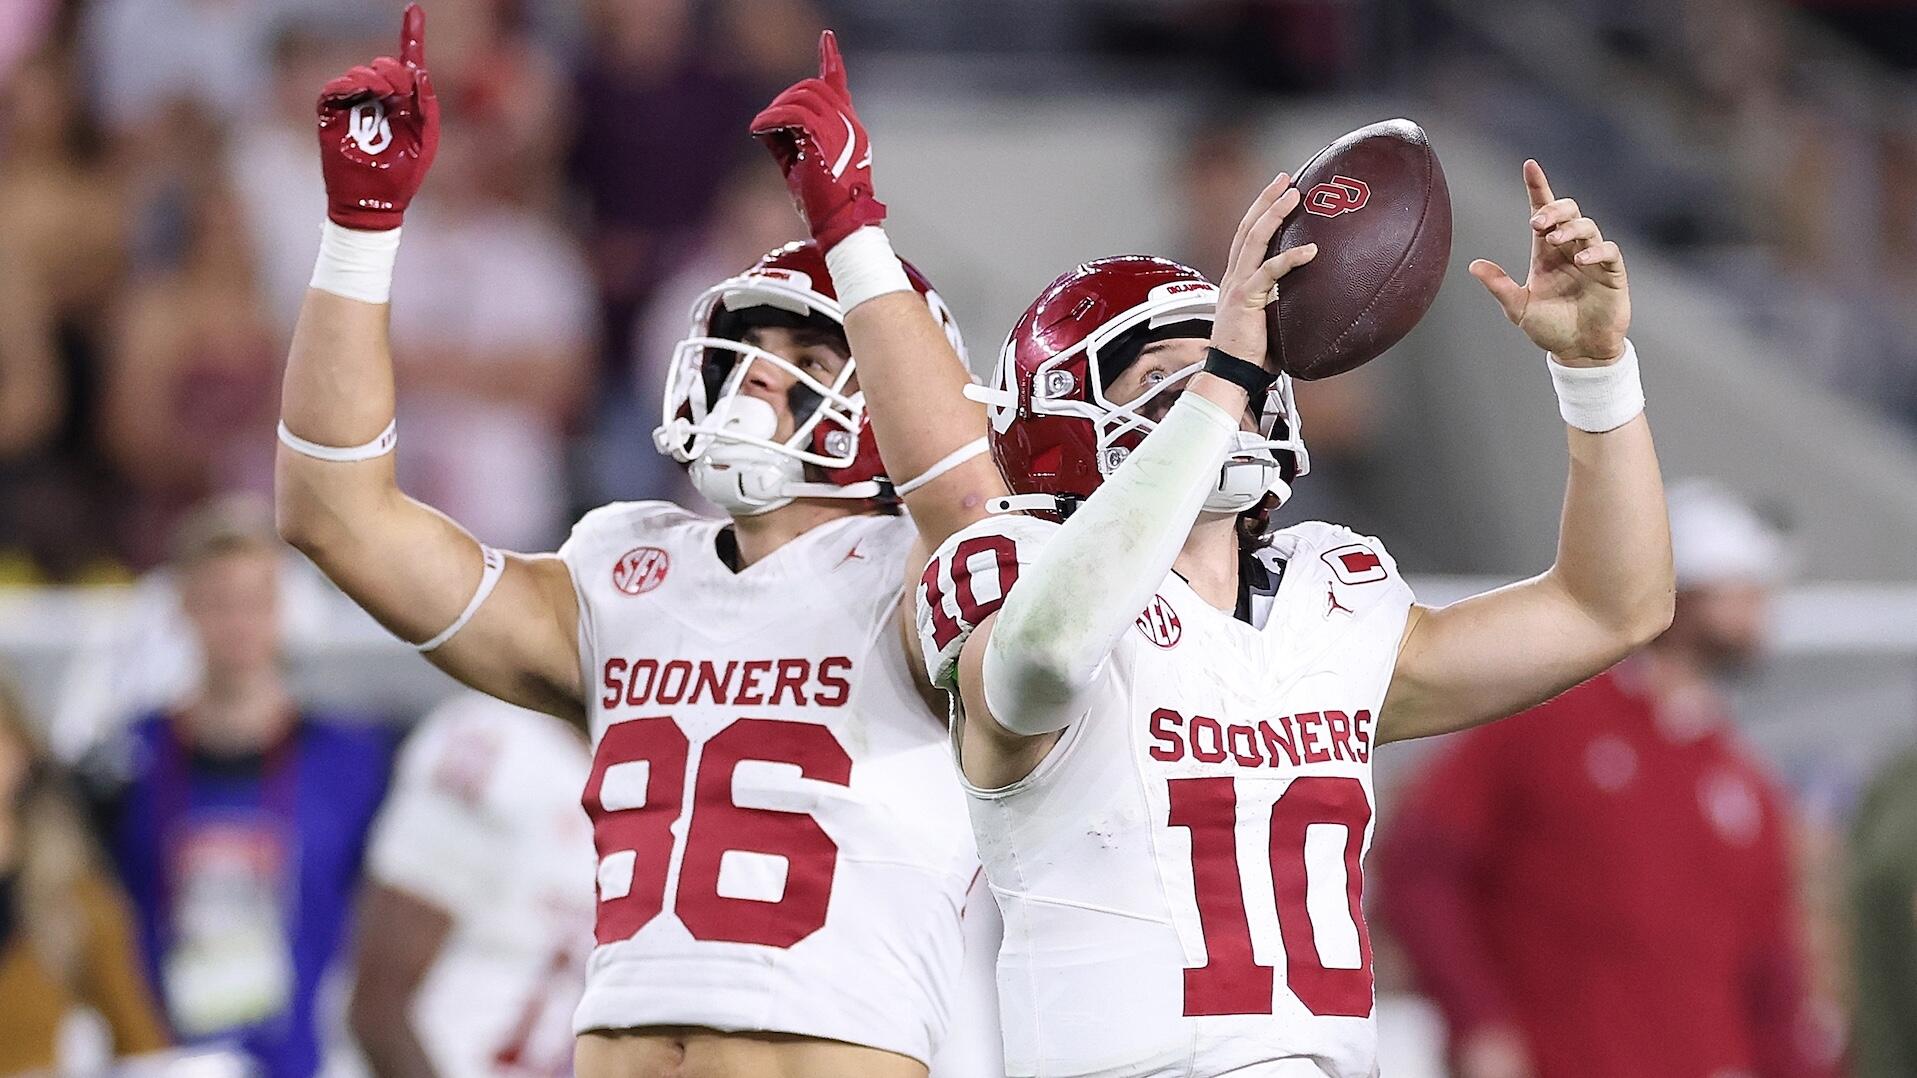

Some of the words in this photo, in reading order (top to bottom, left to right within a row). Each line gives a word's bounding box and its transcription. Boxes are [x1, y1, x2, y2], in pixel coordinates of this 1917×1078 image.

[349, 101, 393, 155] OU
[1303, 175, 1371, 218] OU
[613, 547, 668, 595] SEC
[921, 534, 1019, 652] 10
[603, 656, 852, 709] SOONERS
[1149, 708, 1371, 768] SOONERS
[581, 716, 853, 949] 86
[1166, 776, 1374, 1018] 10
